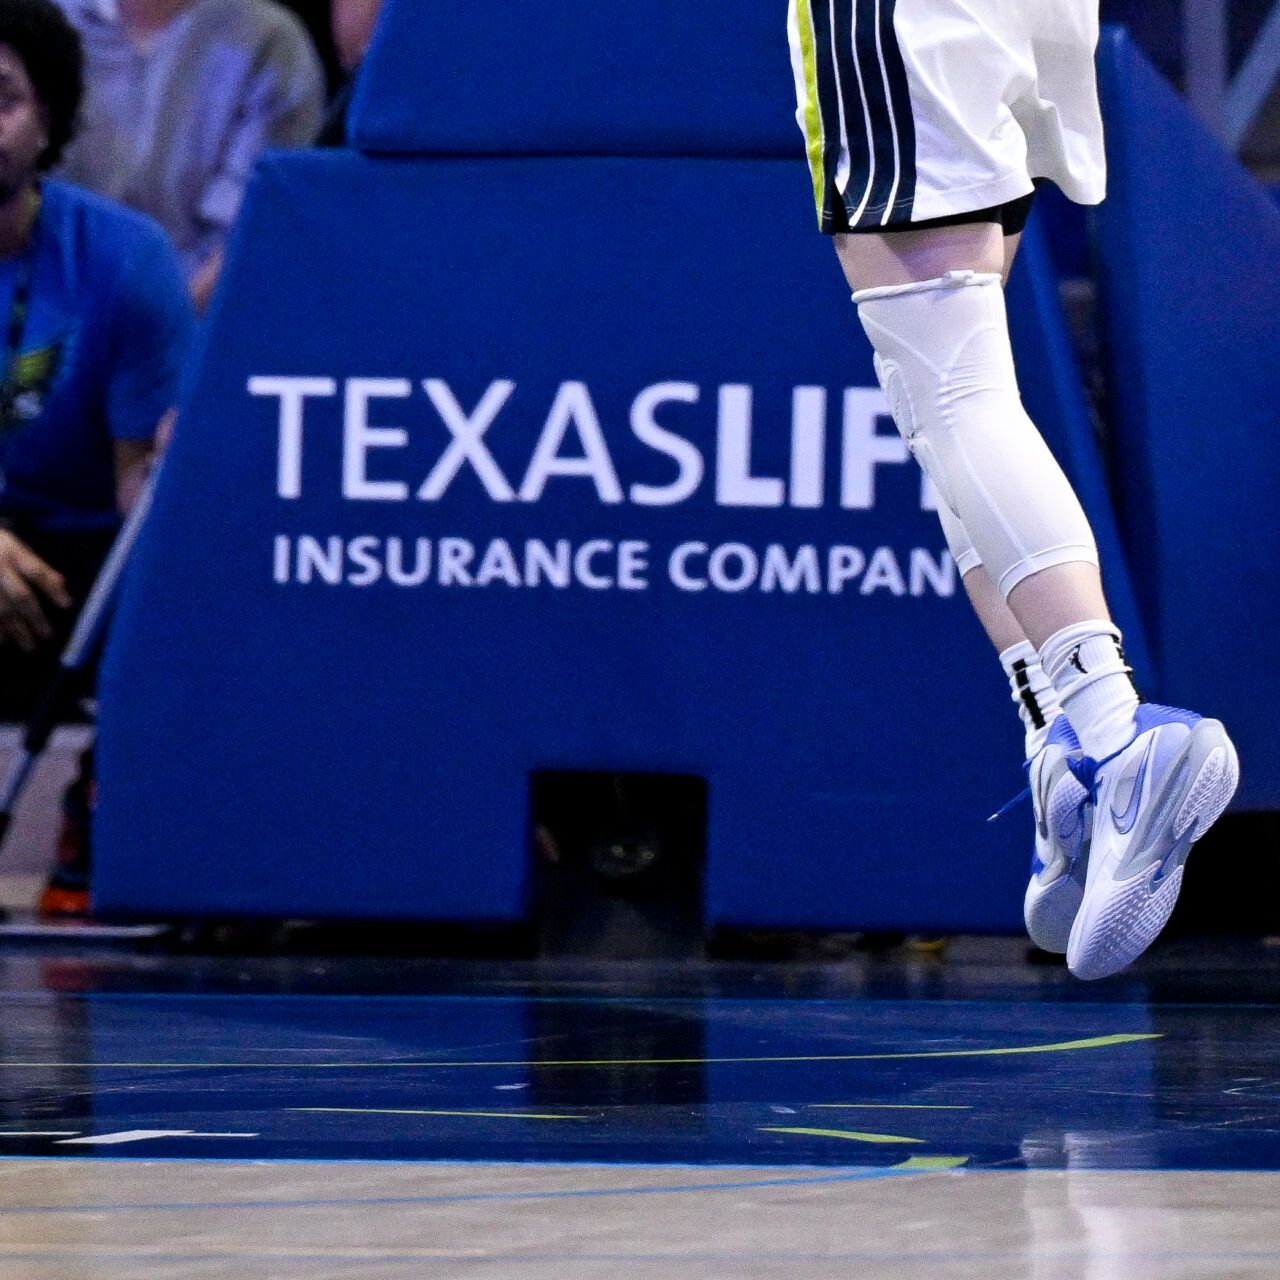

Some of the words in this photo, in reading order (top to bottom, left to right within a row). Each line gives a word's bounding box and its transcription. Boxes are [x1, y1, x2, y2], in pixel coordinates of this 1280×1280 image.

[247, 375, 939, 511] TEXASLIF
[272, 534, 649, 591] INSURANCE
[669, 540, 956, 598] COMPAN
